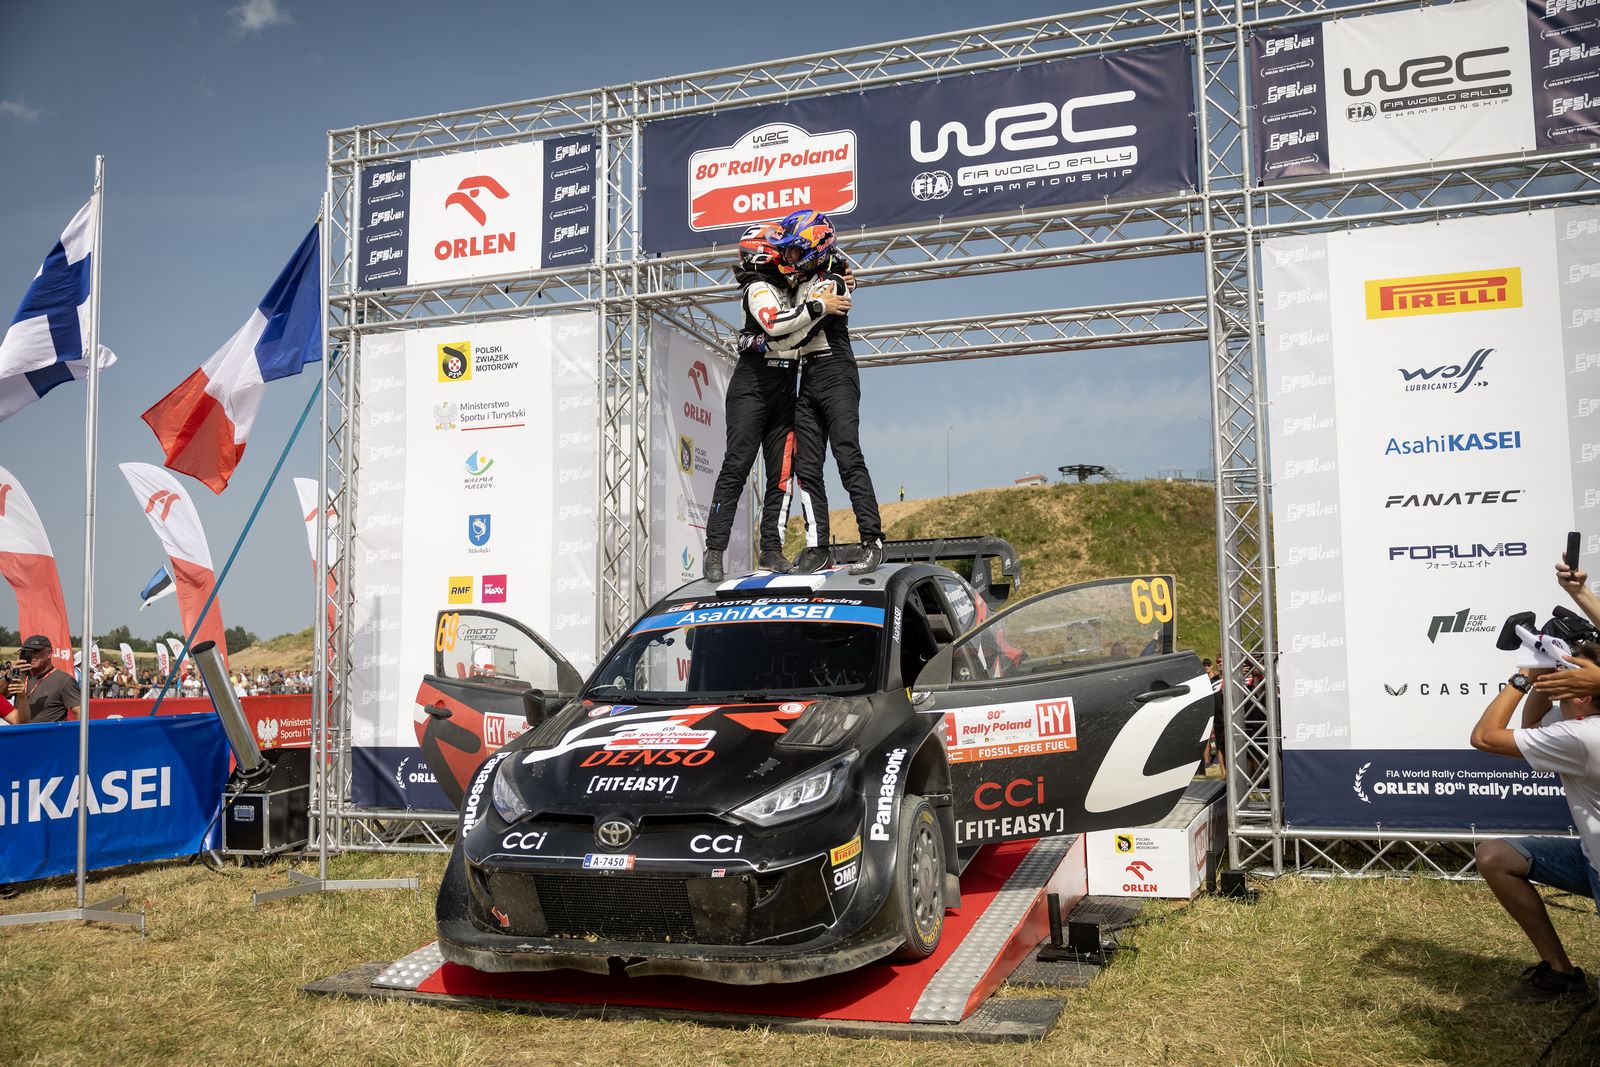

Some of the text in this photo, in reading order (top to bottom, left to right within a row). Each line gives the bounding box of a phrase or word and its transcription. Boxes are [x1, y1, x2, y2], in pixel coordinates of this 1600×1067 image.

[1343, 46, 1511, 97] WRC
[1384, 87, 1508, 109] FIA WORLD RALLY
[1384, 99, 1509, 119] CHAMPIONSHIP
[910, 90, 1137, 163] WRC
[753, 130, 789, 143] WRC
[696, 162, 727, 180] 80th
[727, 156, 776, 176] Rally
[778, 144, 849, 168] Poland
[963, 151, 1132, 180] FIA WORLD RALLY
[963, 169, 1132, 196] CHAMPIONSHIP
[732, 186, 811, 214] ORLEN
[434, 231, 515, 261] ORLEN
[1379, 276, 1507, 311] PIRELLI
[475, 346, 502, 354] POLSKI
[476, 354, 509, 363] ZWIĄZEK
[476, 362, 519, 372] MOTOROWY
[1405, 381, 1458, 392] LUBRICANTS
[460, 401, 509, 411] Ministerstwo
[684, 401, 712, 427] ORLEN
[460, 412, 485, 423] Sportu
[491, 408, 526, 420] Turystyki
[1385, 430, 1521, 455] AsahiKASEI
[1385, 489, 1521, 508] FANATEC
[1389, 542, 1527, 560] FORUM8
[1425, 560, 1491, 570] フォーラムエイト
[451, 586, 470, 595] RMF
[698, 597, 862, 609] TOYOTA GAZOO Racing
[1130, 577, 1173, 625] 69
[676, 605, 836, 625] AsahiKASEI
[436, 612, 460, 652] 69
[1465, 625, 1496, 633] CHANGE
[962, 723, 991, 736] Rally
[992, 718, 1032, 732] Poland
[1038, 703, 1066, 735] HY
[281, 729, 302, 739] Sportu
[488, 717, 504, 744] HY
[580, 749, 716, 767] DENSO
[978, 740, 1070, 758] FOSSIL-FREE FUEL
[409, 772, 439, 783] ORLE
[1386, 769, 1555, 781] FIA World Rally Championship 2024
[870, 748, 907, 841] Panasonic
[1373, 782, 1429, 796] ORLEN
[1434, 781, 1466, 796] 80th
[1469, 781, 1509, 799] Rally
[834, 840, 861, 863] PIRELLI
[592, 857, 624, 867] A-7450
[833, 865, 857, 884] OMP
[1122, 883, 1158, 893] ORLEN
